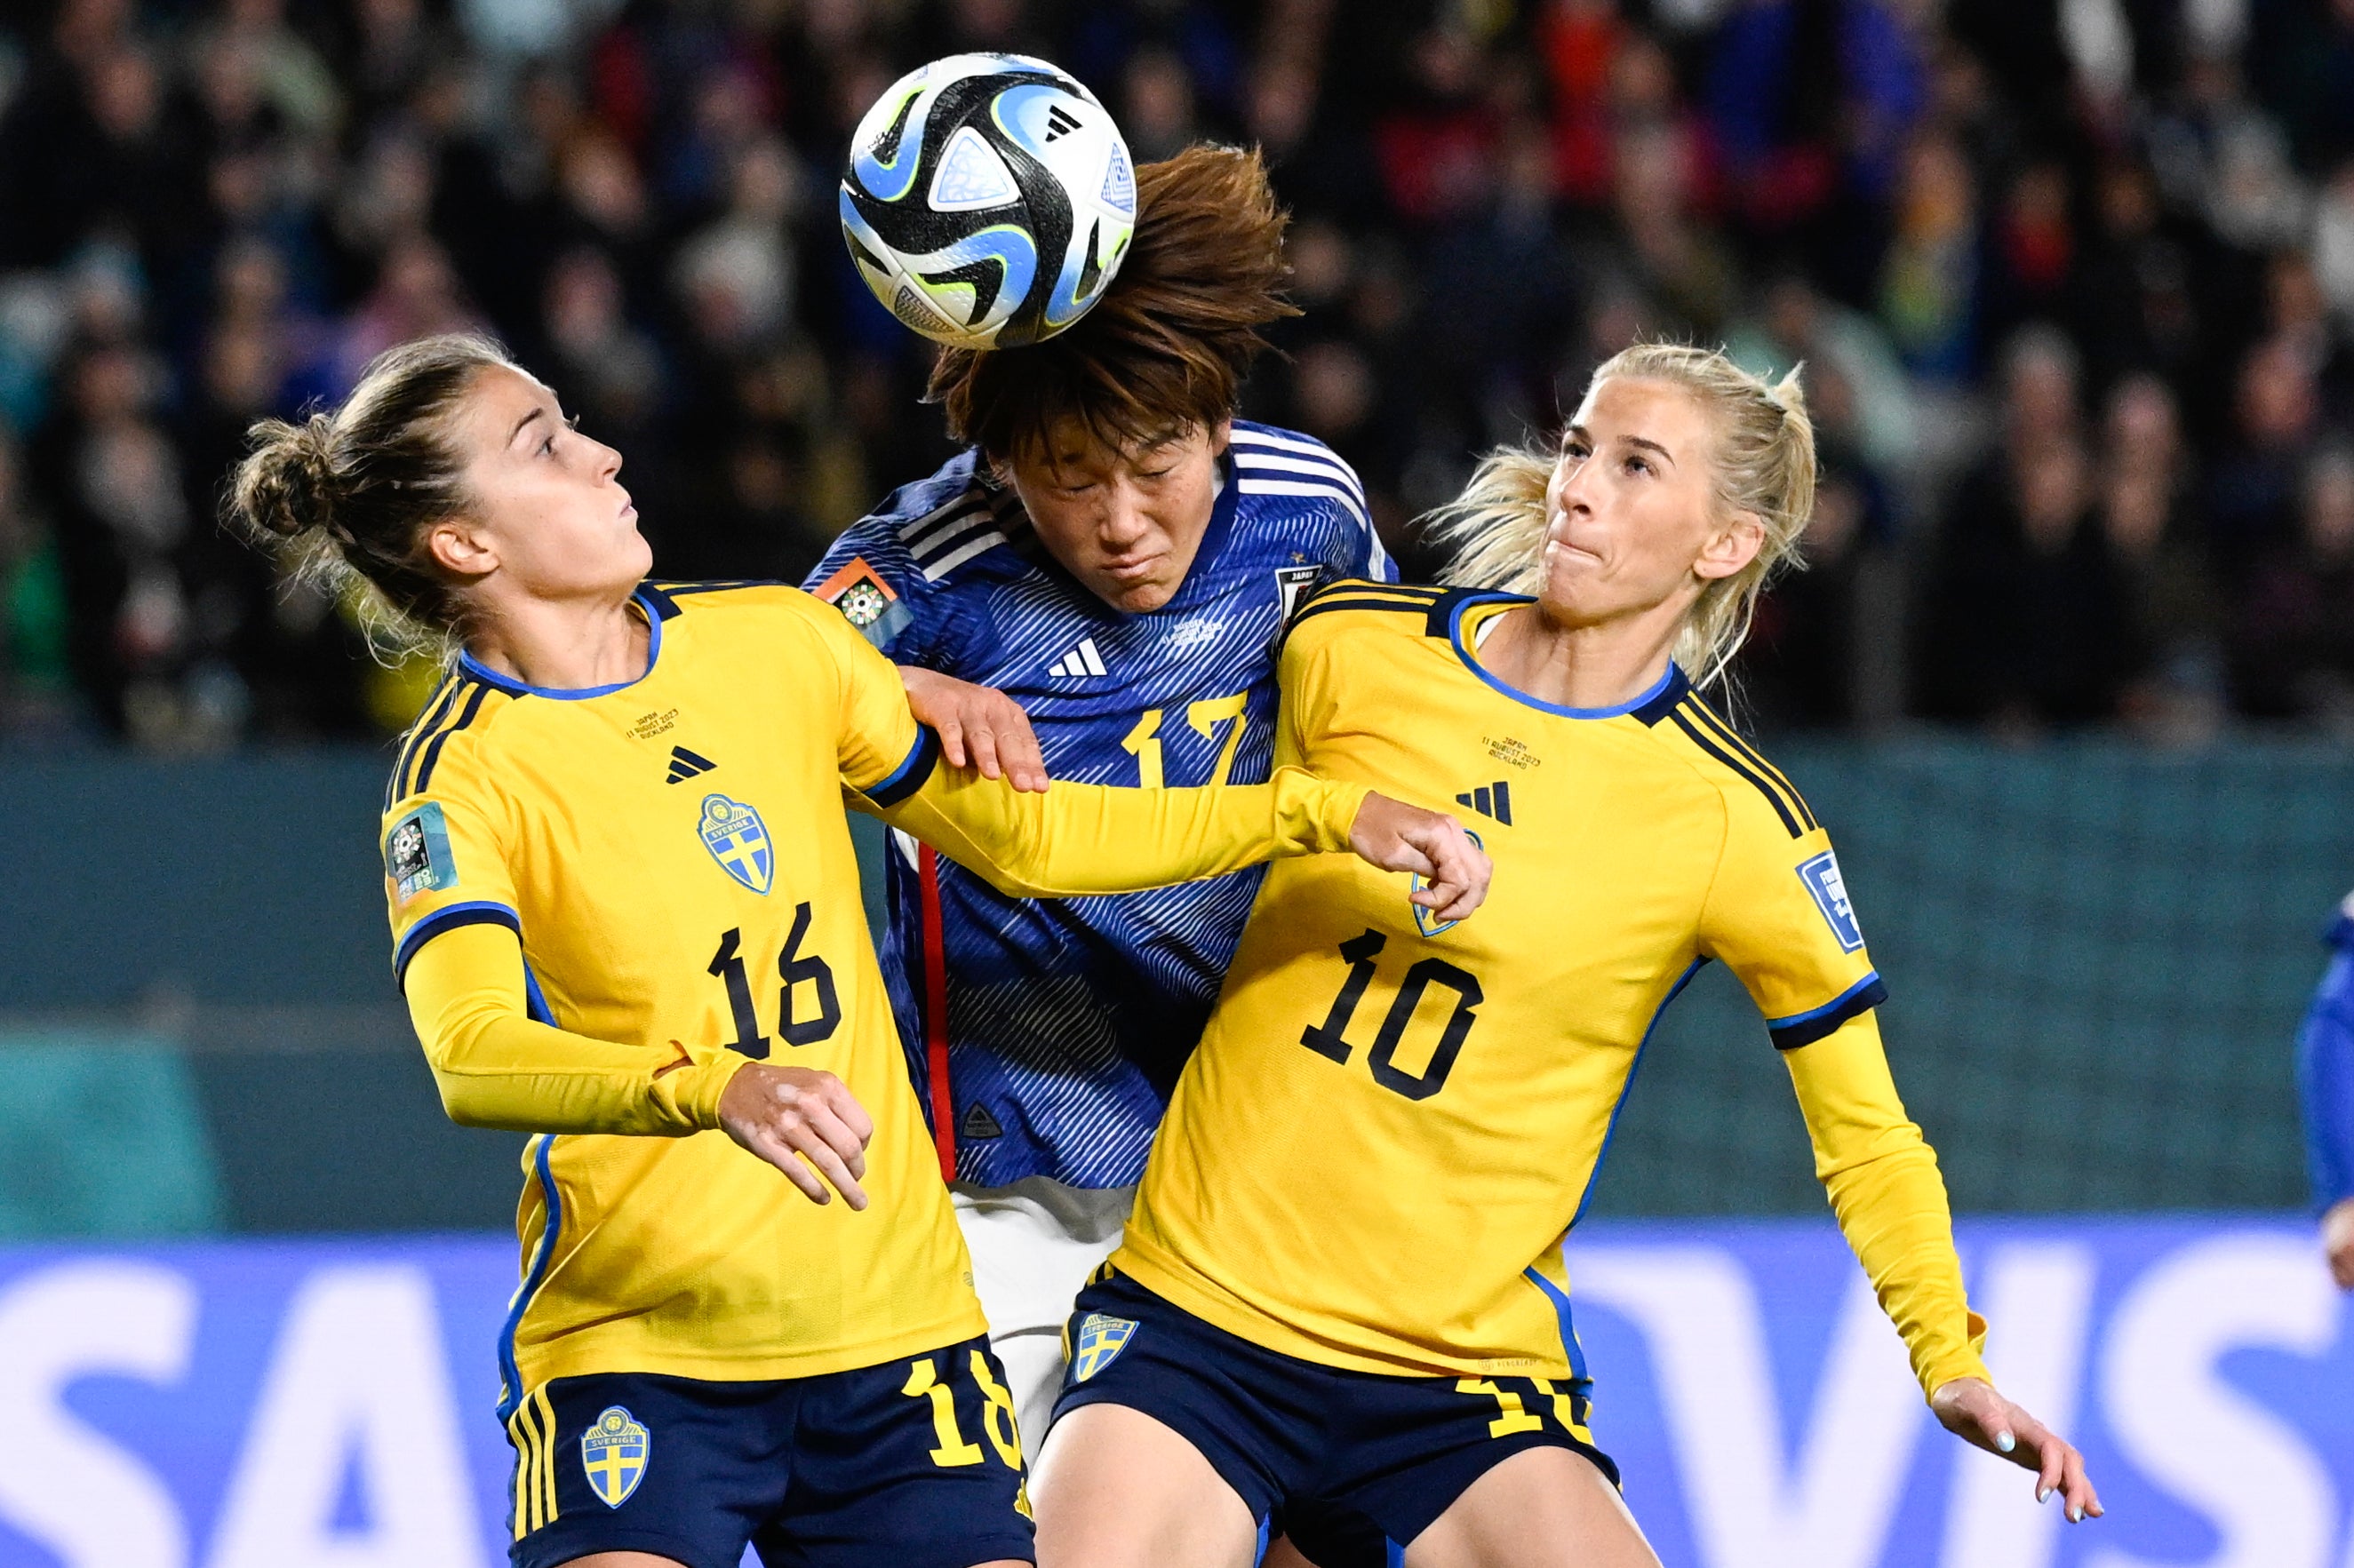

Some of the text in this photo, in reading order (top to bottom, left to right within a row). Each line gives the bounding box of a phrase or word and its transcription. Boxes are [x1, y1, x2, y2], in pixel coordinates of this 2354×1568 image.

[626, 730, 634, 739] 11
[659, 708, 679, 724] 2023
[1121, 690, 1249, 788] 17
[1481, 736, 1490, 745] 11
[1521, 753, 1541, 767] 2023
[707, 901, 842, 1060] 16
[1299, 927, 1485, 1102] 10
[591, 1436, 636, 1447] SVERIGE
